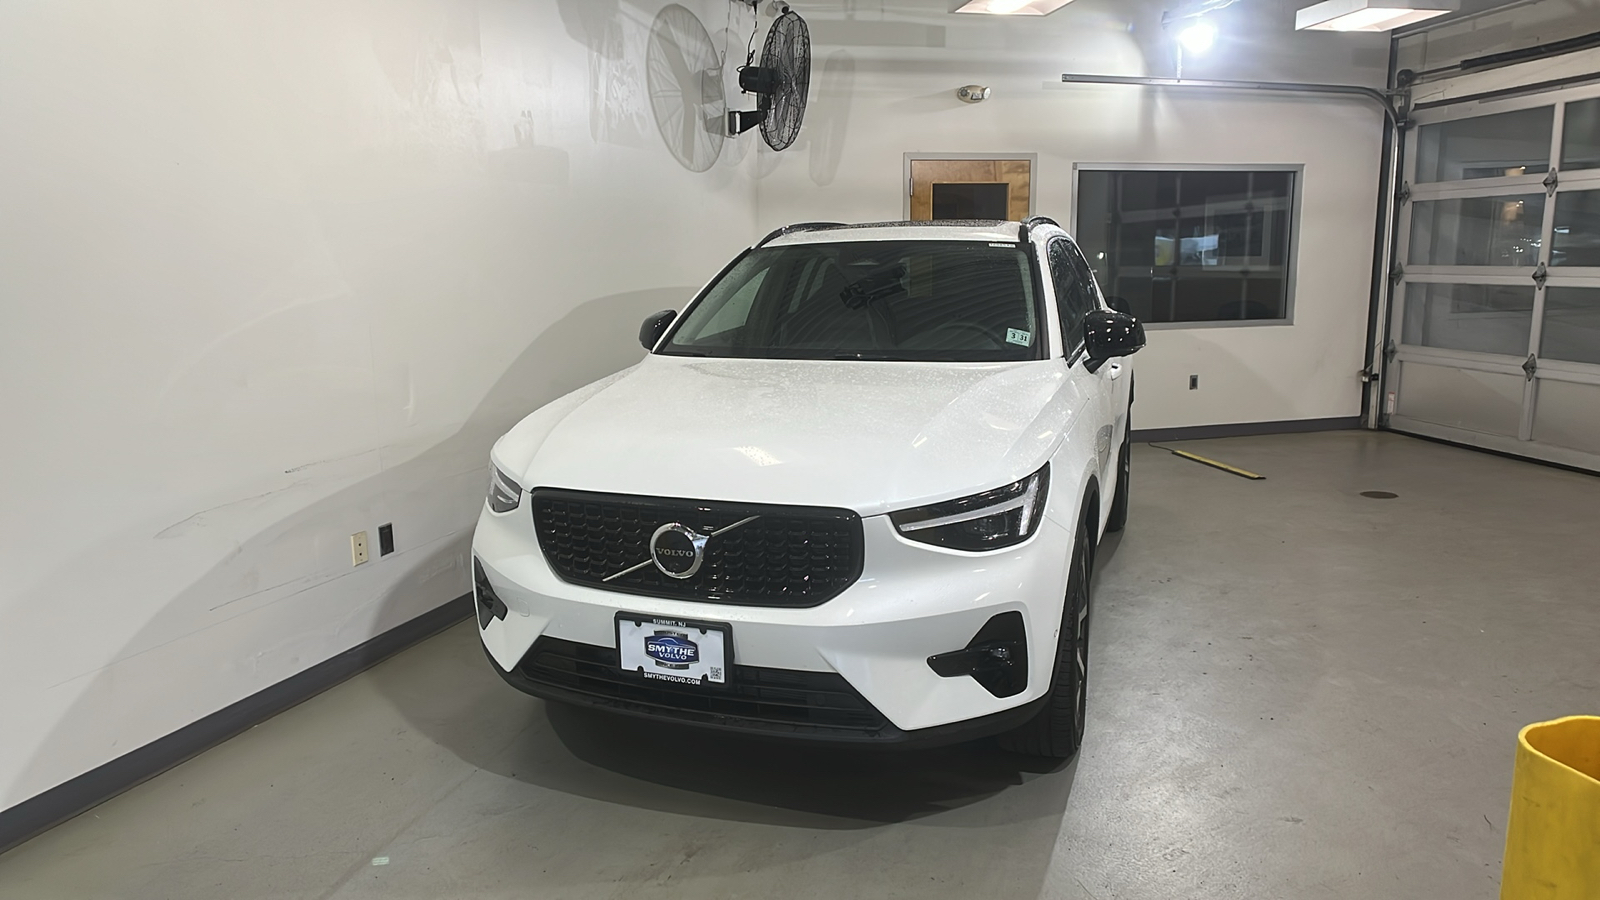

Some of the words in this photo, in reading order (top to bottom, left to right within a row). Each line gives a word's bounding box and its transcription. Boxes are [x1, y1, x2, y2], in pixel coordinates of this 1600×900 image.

[656, 548, 694, 557] VOLVO
[648, 644, 695, 656] SMYTHE
[644, 672, 700, 685] SMYTHEVOLVO.COM
